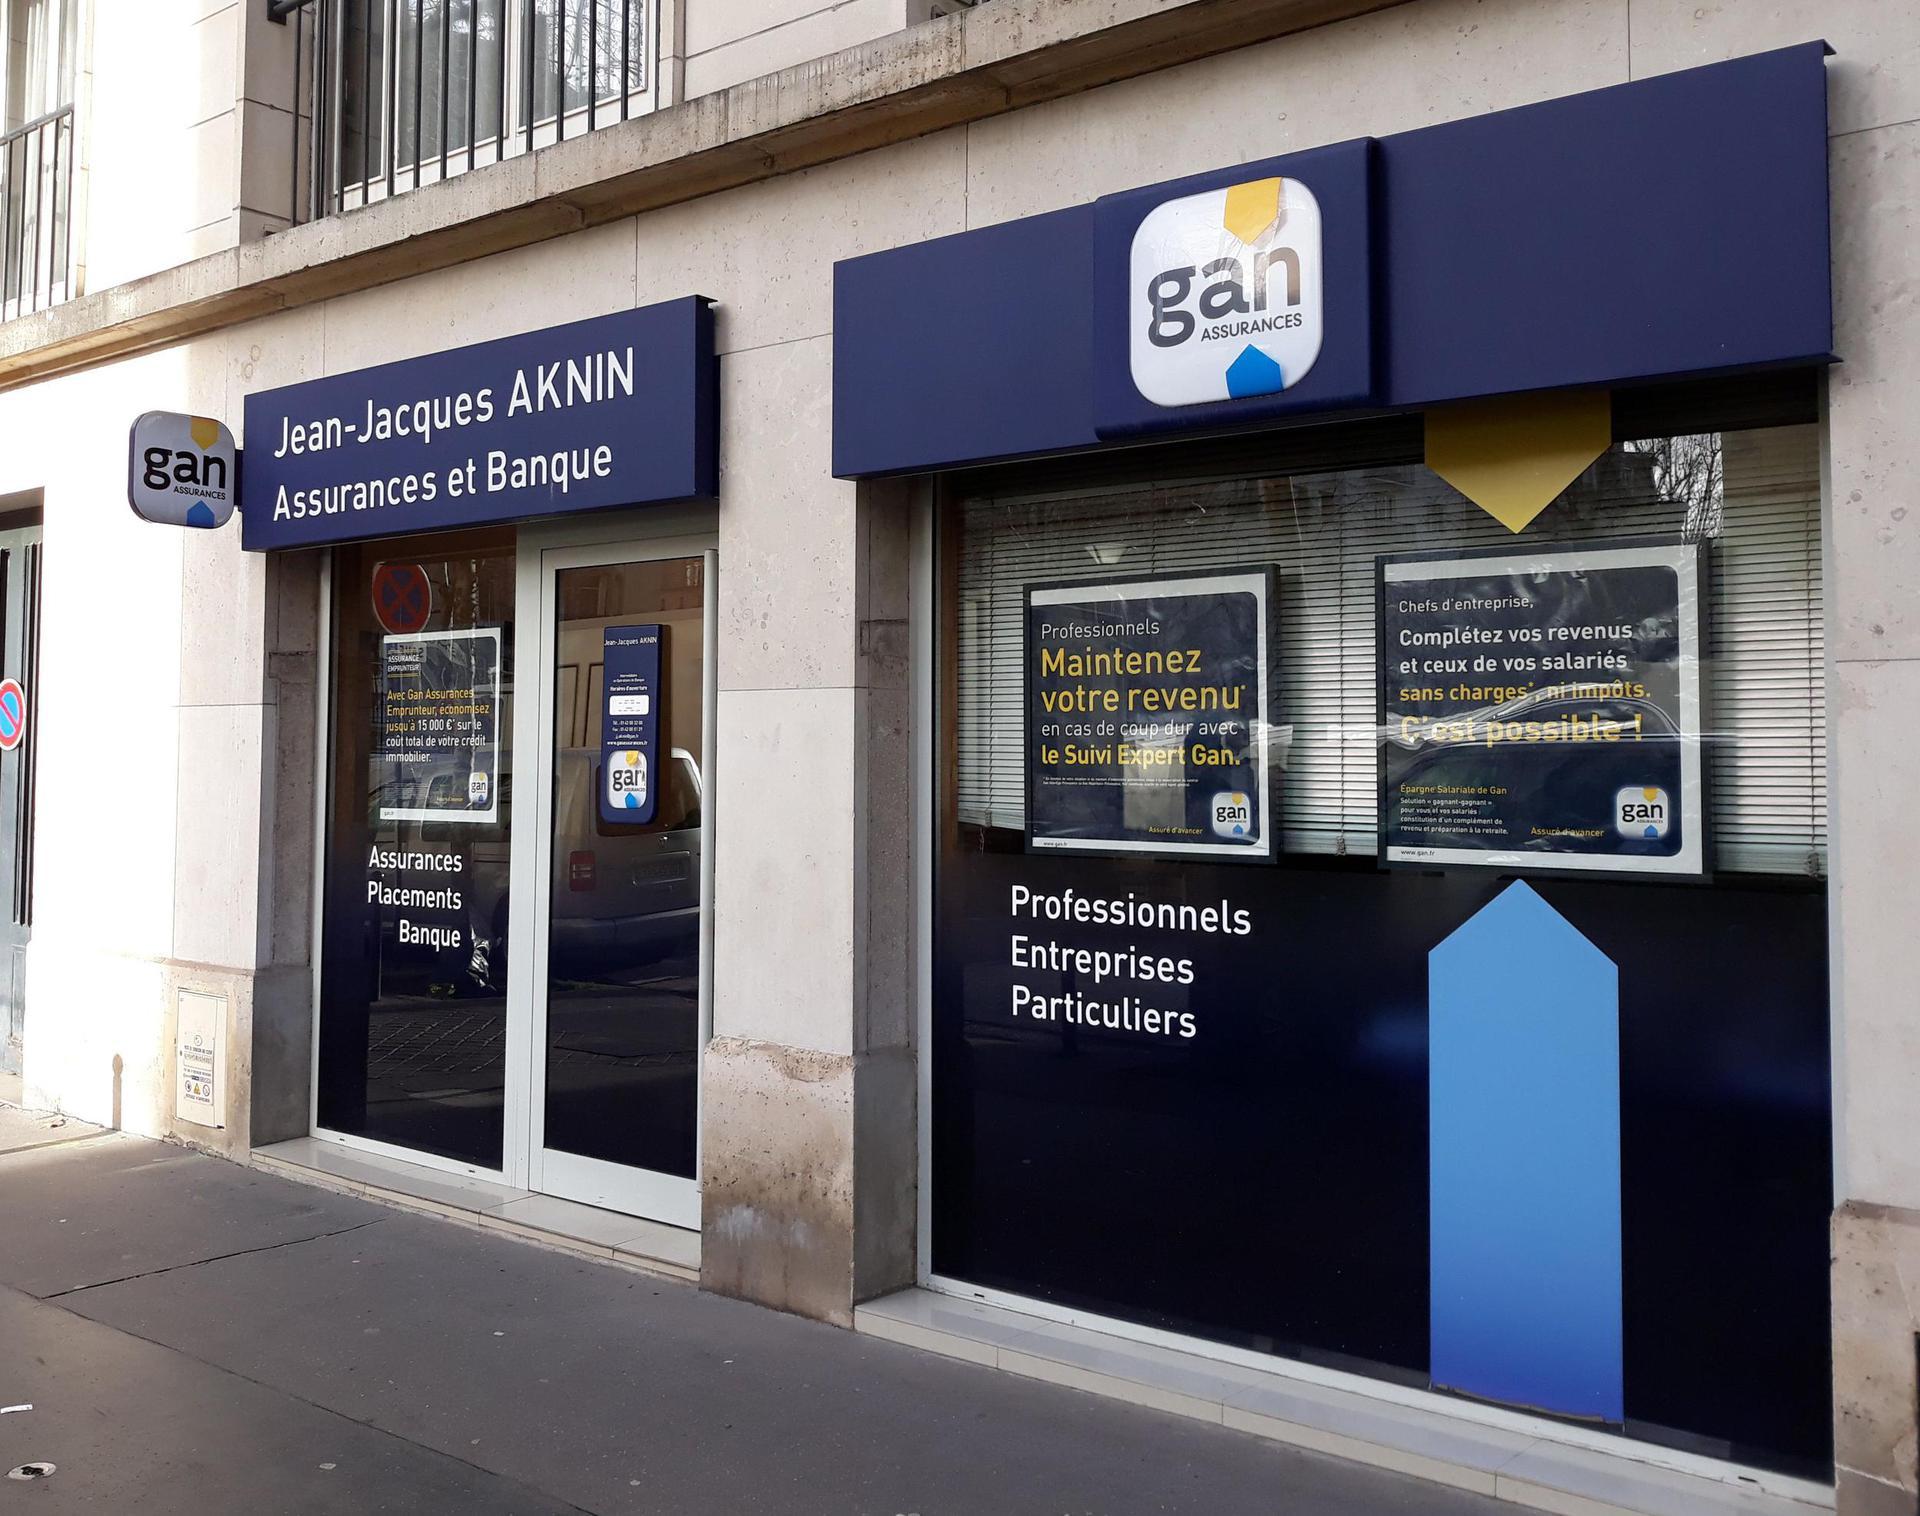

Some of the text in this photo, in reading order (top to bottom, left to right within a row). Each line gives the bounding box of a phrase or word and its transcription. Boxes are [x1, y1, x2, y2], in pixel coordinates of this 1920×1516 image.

[1147, 247, 1301, 347] gan
[1201, 313, 1302, 341] ASSURANCES
[274, 347, 633, 459] Jean-Jacques AKNIN
[143, 447, 226, 490] gan
[174, 486, 226, 500] ASSURANCES
[273, 445, 612, 521] Assurances et Banque
[1399, 595, 1534, 613] Chefs d'entreprise,
[1041, 618, 1160, 640] Professionnels
[1399, 623, 1633, 648] Complétez vos revenus
[604, 636, 657, 646] Jean-Jacques AKNIN
[387, 664, 421, 672] EMPRUNTEUR
[388, 654, 420, 663] ASSURANCE
[1041, 647, 1202, 677] Maintenez
[1399, 649, 1628, 674] et ceux de vos salariés
[387, 687, 475, 700] Avec Gan Assurances
[1041, 685, 1120, 713] votre
[1399, 687, 1444, 701] sans
[1547, 681, 1564, 699] ni
[1572, 679, 1651, 702] impôts.
[387, 702, 490, 717] Emprunteur, économisez
[386, 719, 416, 734] jusqu'à
[418, 719, 428, 731] 15
[429, 719, 444, 731] 000
[457, 721, 471, 731] sur
[472, 719, 482, 730] le
[1041, 719, 1238, 740] en cas de coup dur avec
[1399, 712, 1642, 748] C'est possible !
[386, 734, 404, 747] coût
[405, 735, 424, 747] total
[425, 736, 436, 747] de
[461, 733, 486, 747] crédit
[385, 751, 432, 763] immobilier.
[1041, 743, 1241, 769] le Suivi Expert Gan.
[470, 781, 487, 793] gan
[1400, 783, 1507, 795] Épargne Salariale de Gan
[1433, 798, 1487, 806] gagnant-gagnant
[1451, 807, 1477, 815] salariés
[1216, 806, 1247, 823] gan
[1453, 817, 1493, 825] complément
[1621, 803, 1663, 823] gan
[1148, 825, 1203, 835] Assuré d'avancer
[1431, 825, 1468, 833] préparation
[1482, 826, 1509, 834] retraite.
[1530, 826, 1605, 837] Assuré d'avancer
[369, 845, 463, 873] Assurances
[367, 880, 462, 910] Placements
[1011, 885, 1252, 936] Professionnels
[399, 919, 461, 952] Banque
[1011, 935, 1195, 984] Entreprises
[1012, 984, 1197, 1038] Particuliers
